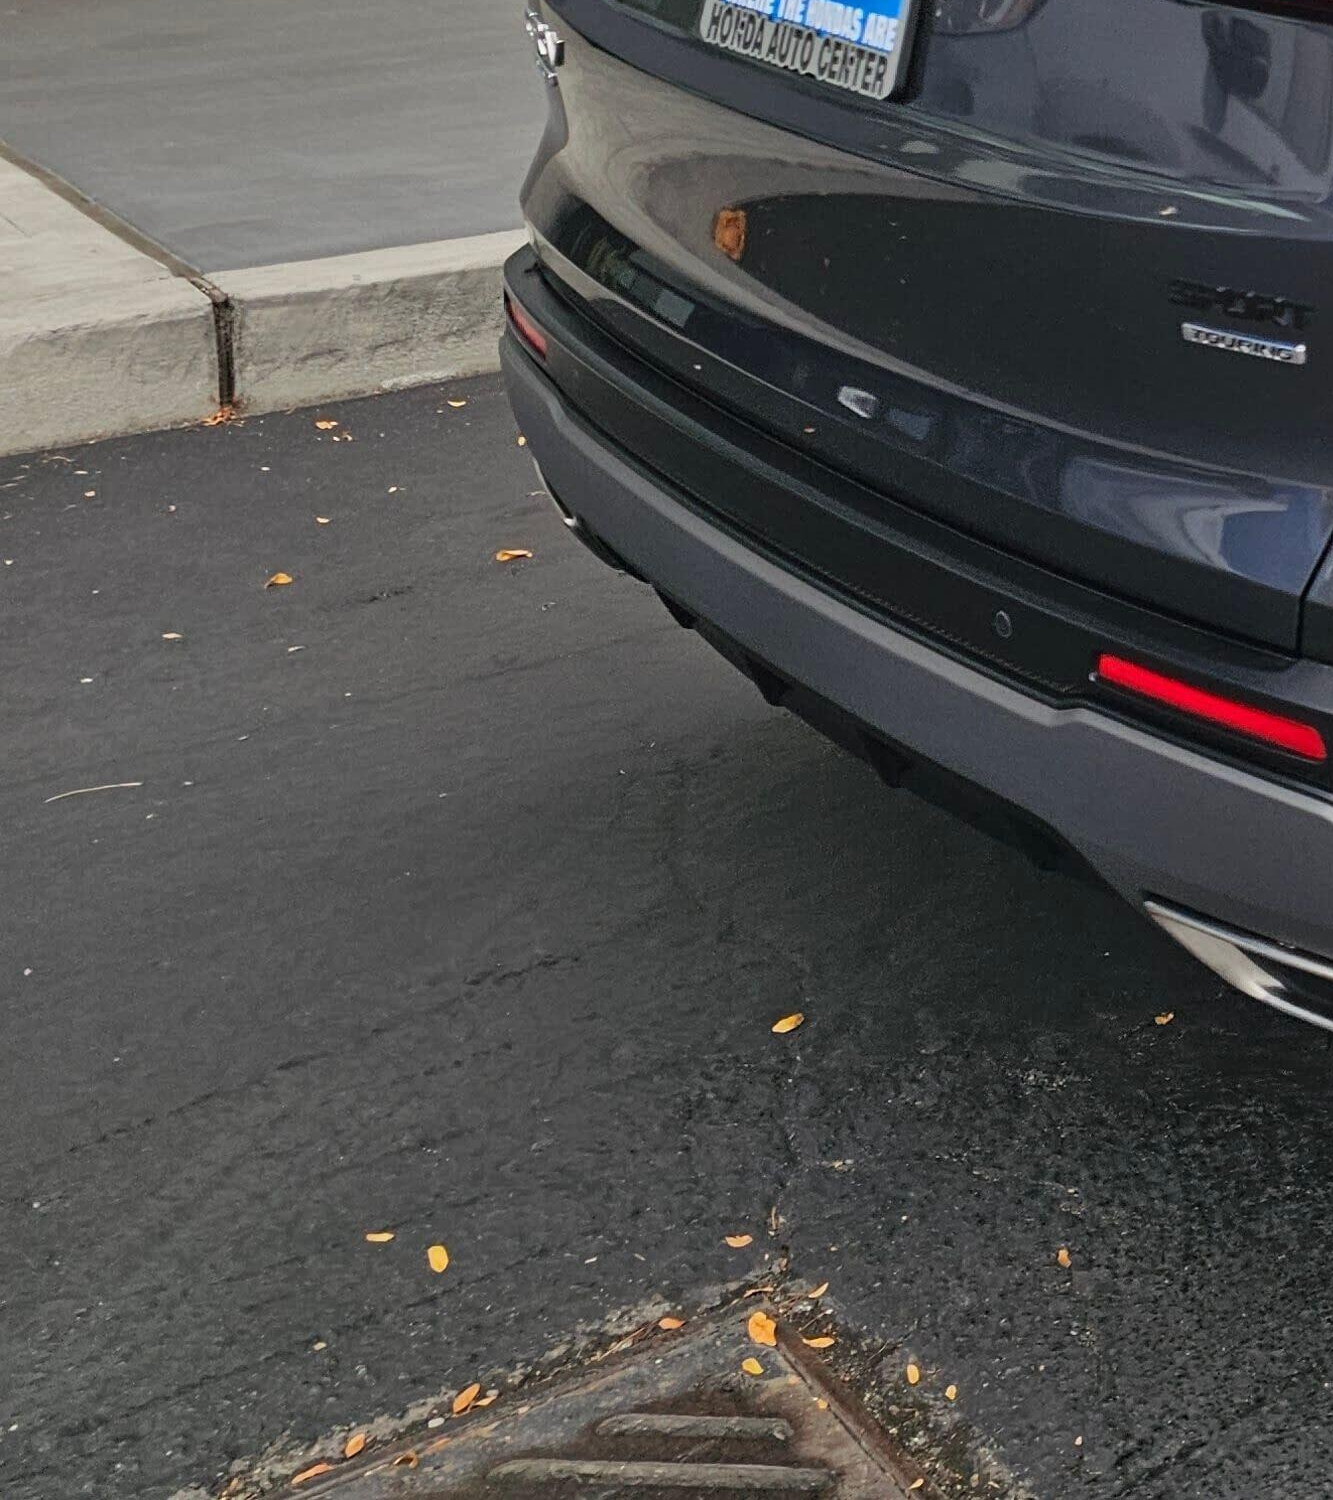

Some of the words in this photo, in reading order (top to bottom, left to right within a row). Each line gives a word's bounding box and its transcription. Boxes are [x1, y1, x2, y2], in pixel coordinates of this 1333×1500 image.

[707, 3, 767, 57] HONDA
[769, 24, 816, 74] AUTO
[817, 38, 889, 95] CENTER
[864, 15, 899, 50] ARE
[1191, 329, 1292, 360] TOURING
